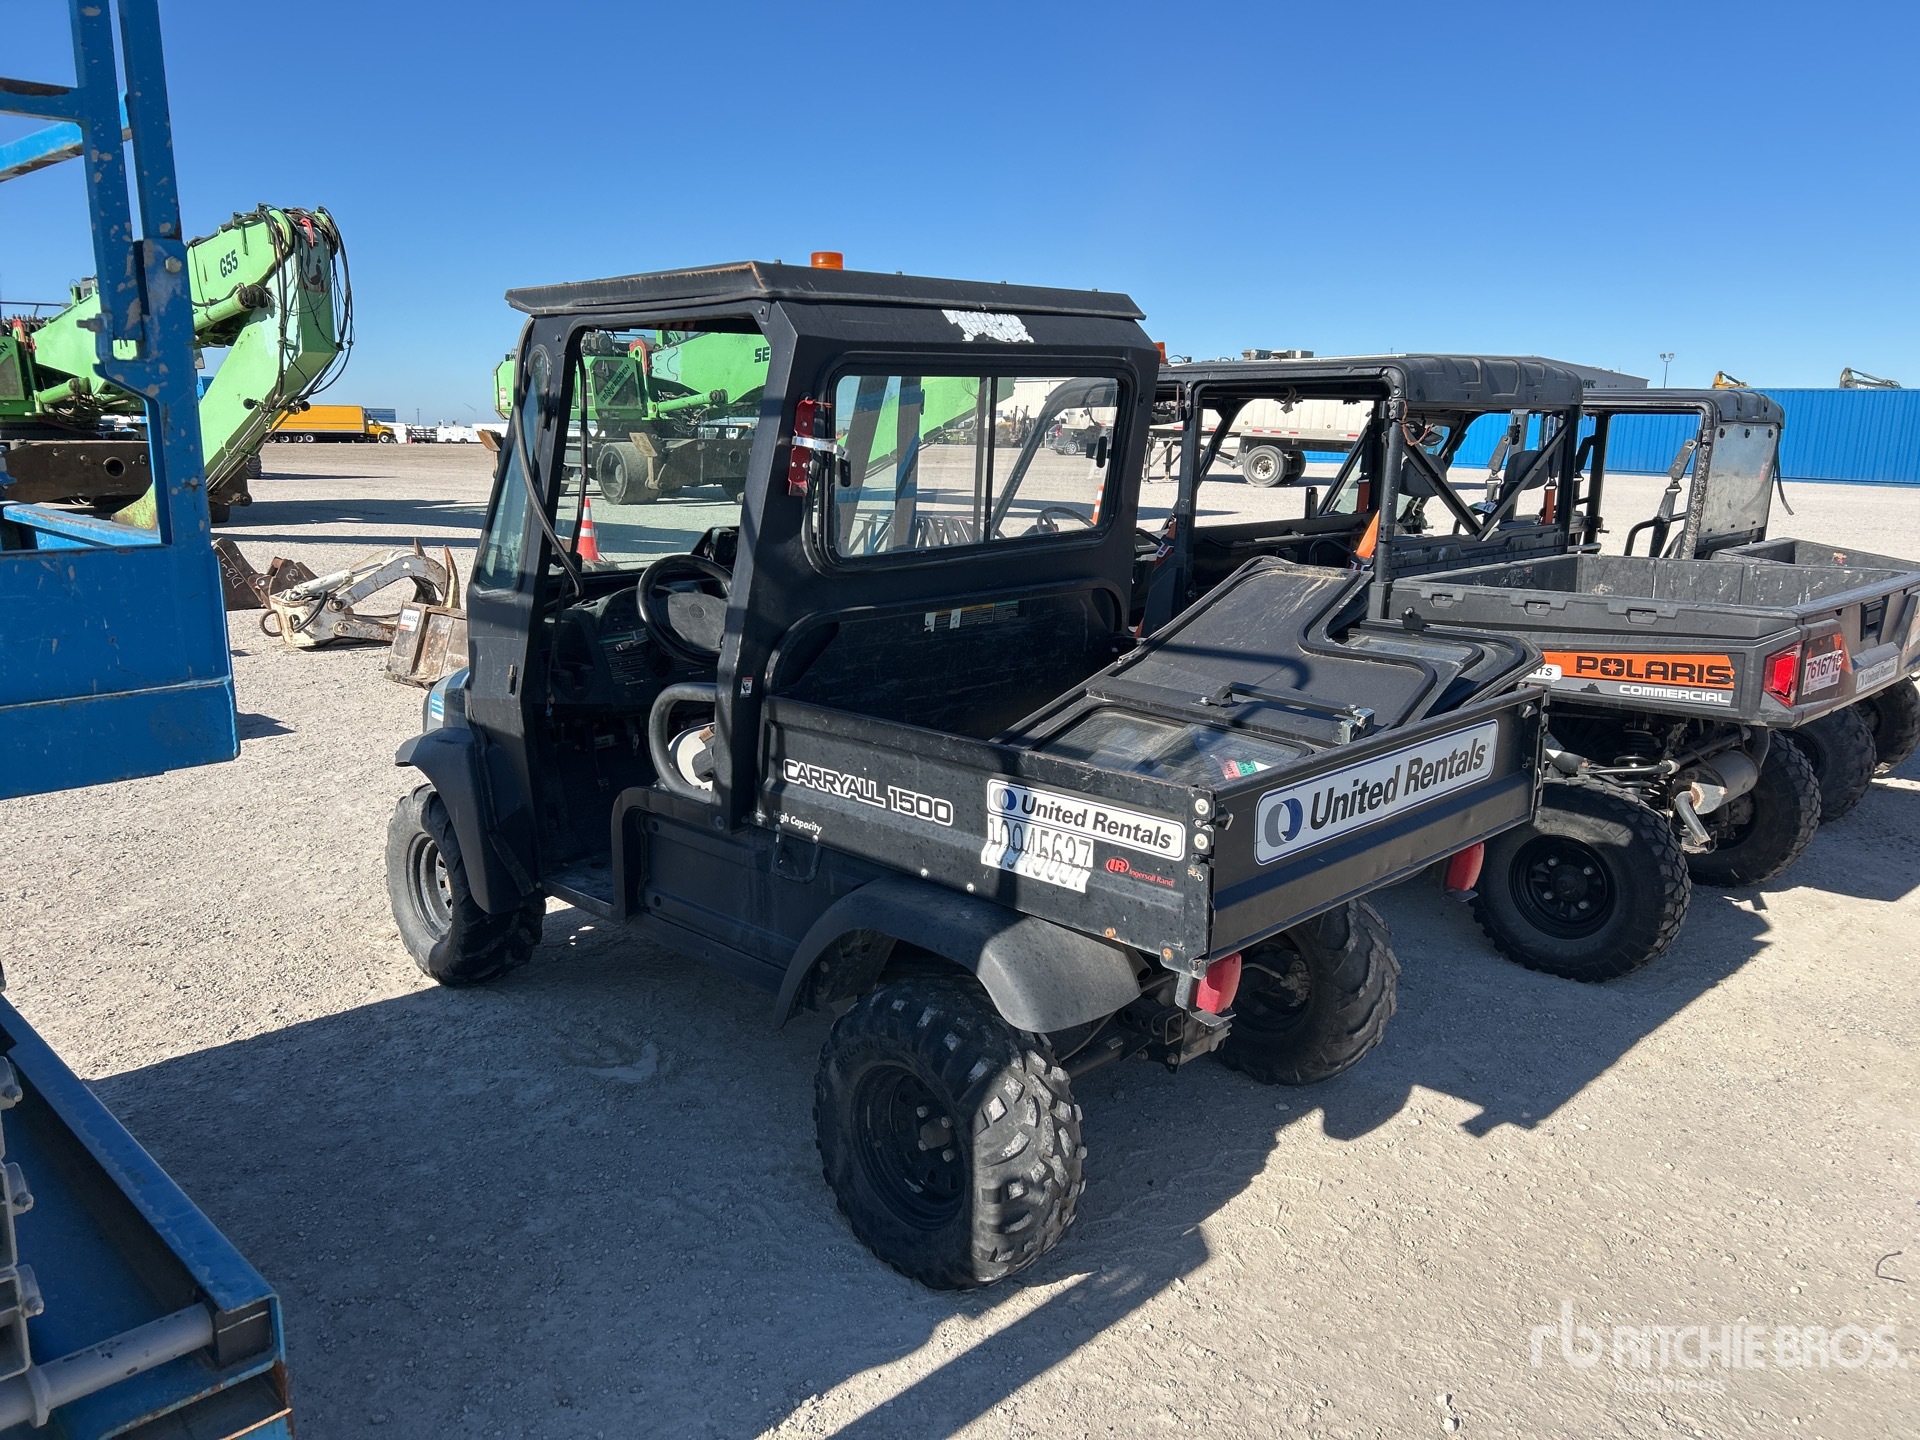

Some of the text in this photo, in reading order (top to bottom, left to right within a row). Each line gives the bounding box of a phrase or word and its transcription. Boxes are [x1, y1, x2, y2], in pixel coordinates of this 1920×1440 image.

[220, 249, 238, 278] G55
[1576, 655, 1734, 685] POLARIS
[1619, 684, 1731, 704] COMMERCIAL
[783, 758, 953, 826] CARRYALL 1500
[1310, 737, 1486, 831] United Rentals
[773, 810, 823, 835] High Capacity
[1021, 794, 1172, 850] United Rentals
[1109, 858, 1174, 888] IR Ingersoll Rand
